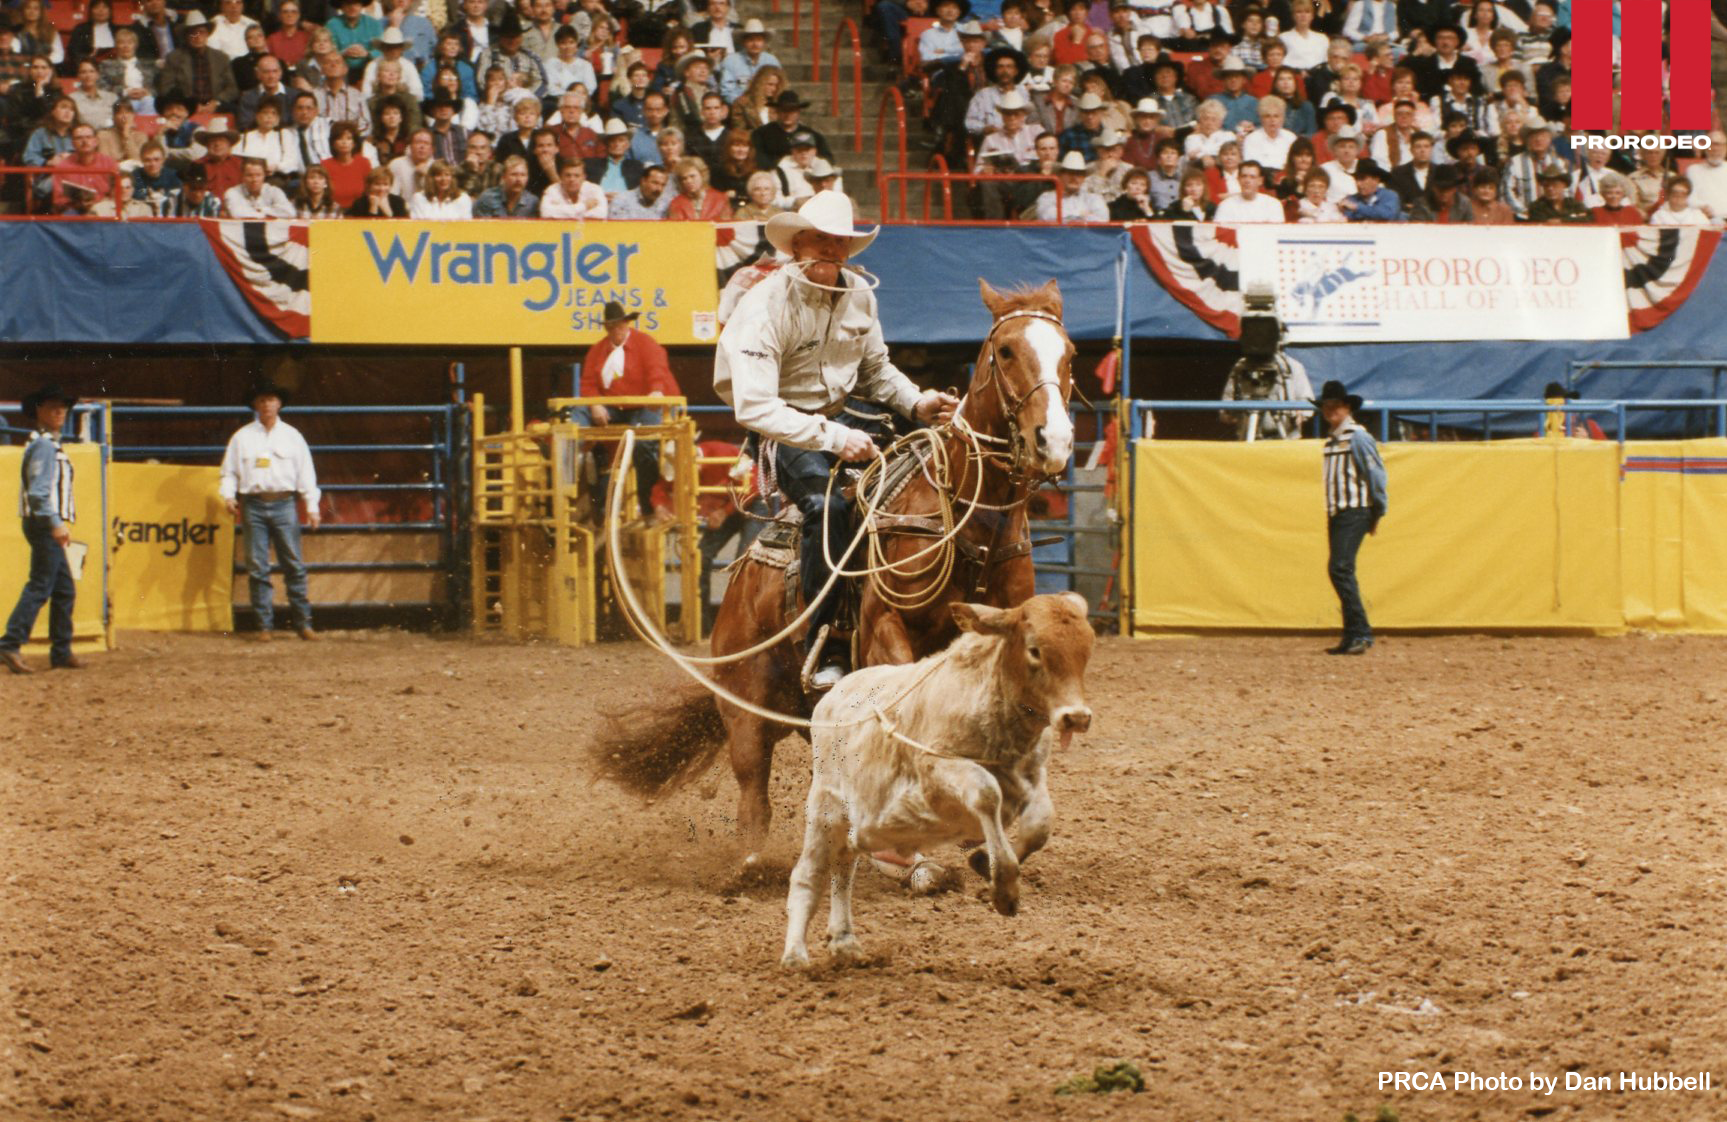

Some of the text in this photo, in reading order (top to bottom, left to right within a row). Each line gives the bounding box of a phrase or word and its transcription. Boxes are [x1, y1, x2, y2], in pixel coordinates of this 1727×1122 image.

[362, 231, 639, 312] Wrangler
[1381, 257, 1580, 287] PRORODEO
[564, 287, 668, 307] JEANS &
[571, 311, 659, 331] SHTS
[112, 516, 220, 557] rangler
